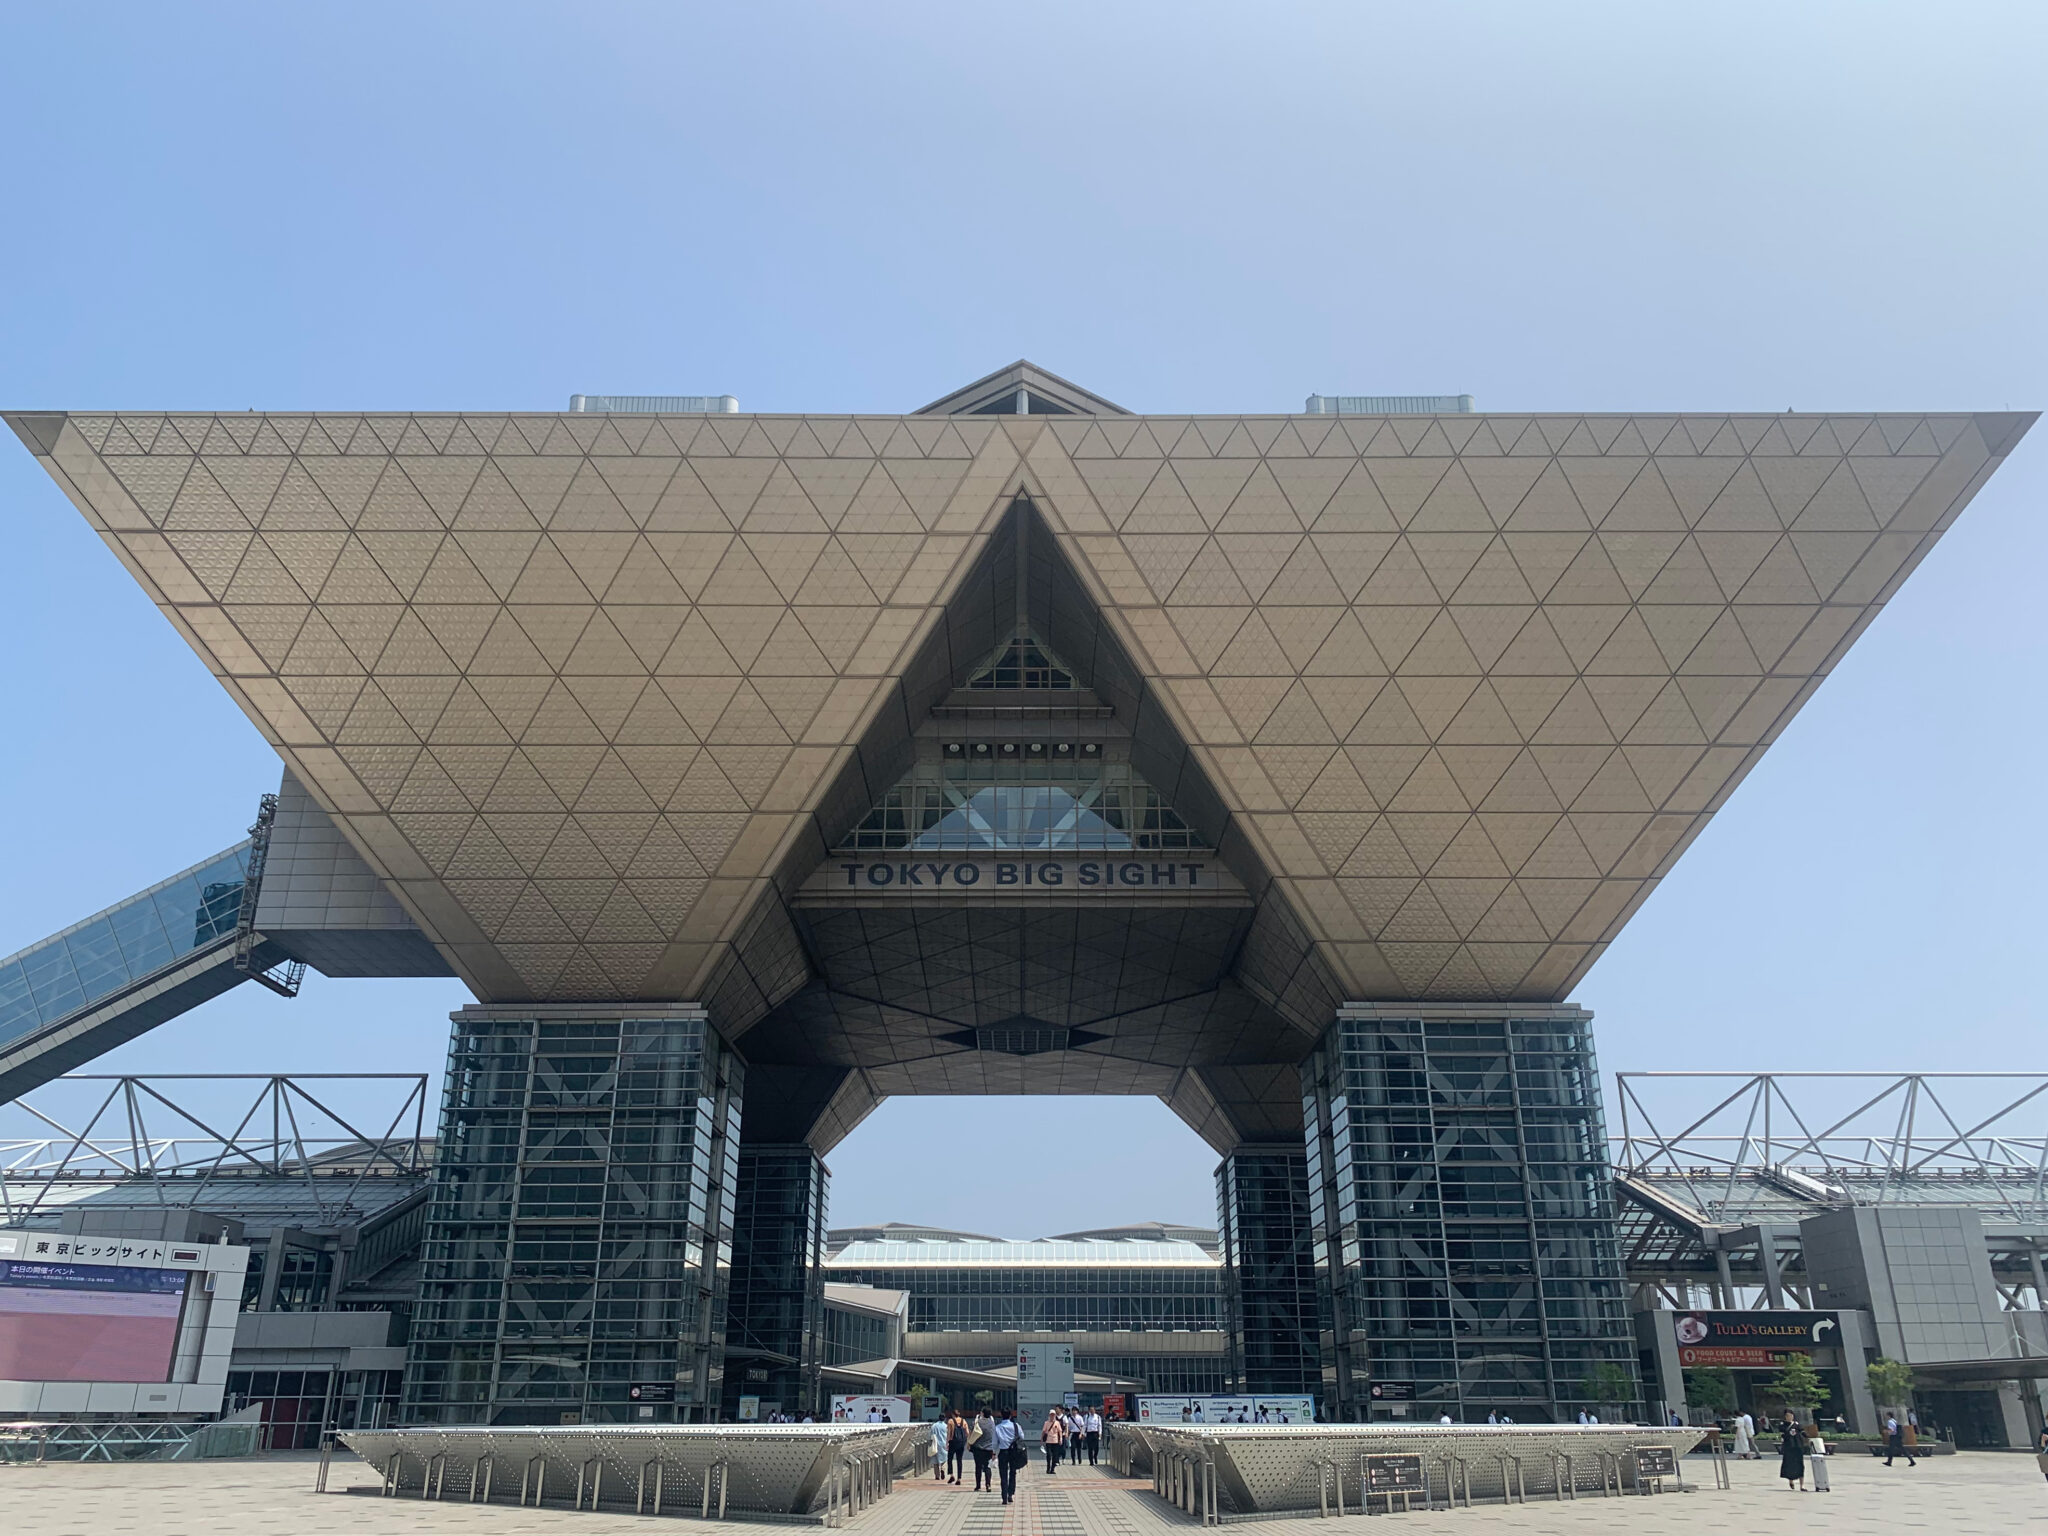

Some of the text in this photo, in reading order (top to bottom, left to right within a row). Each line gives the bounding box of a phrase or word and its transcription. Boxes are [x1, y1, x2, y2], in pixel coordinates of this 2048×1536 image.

[840, 863, 1204, 885] TOKYO BIG SIGHT
[35, 1241, 162, 1260] 東京ビッグサイト
[1758, 1326, 1808, 1335] GALLERY
